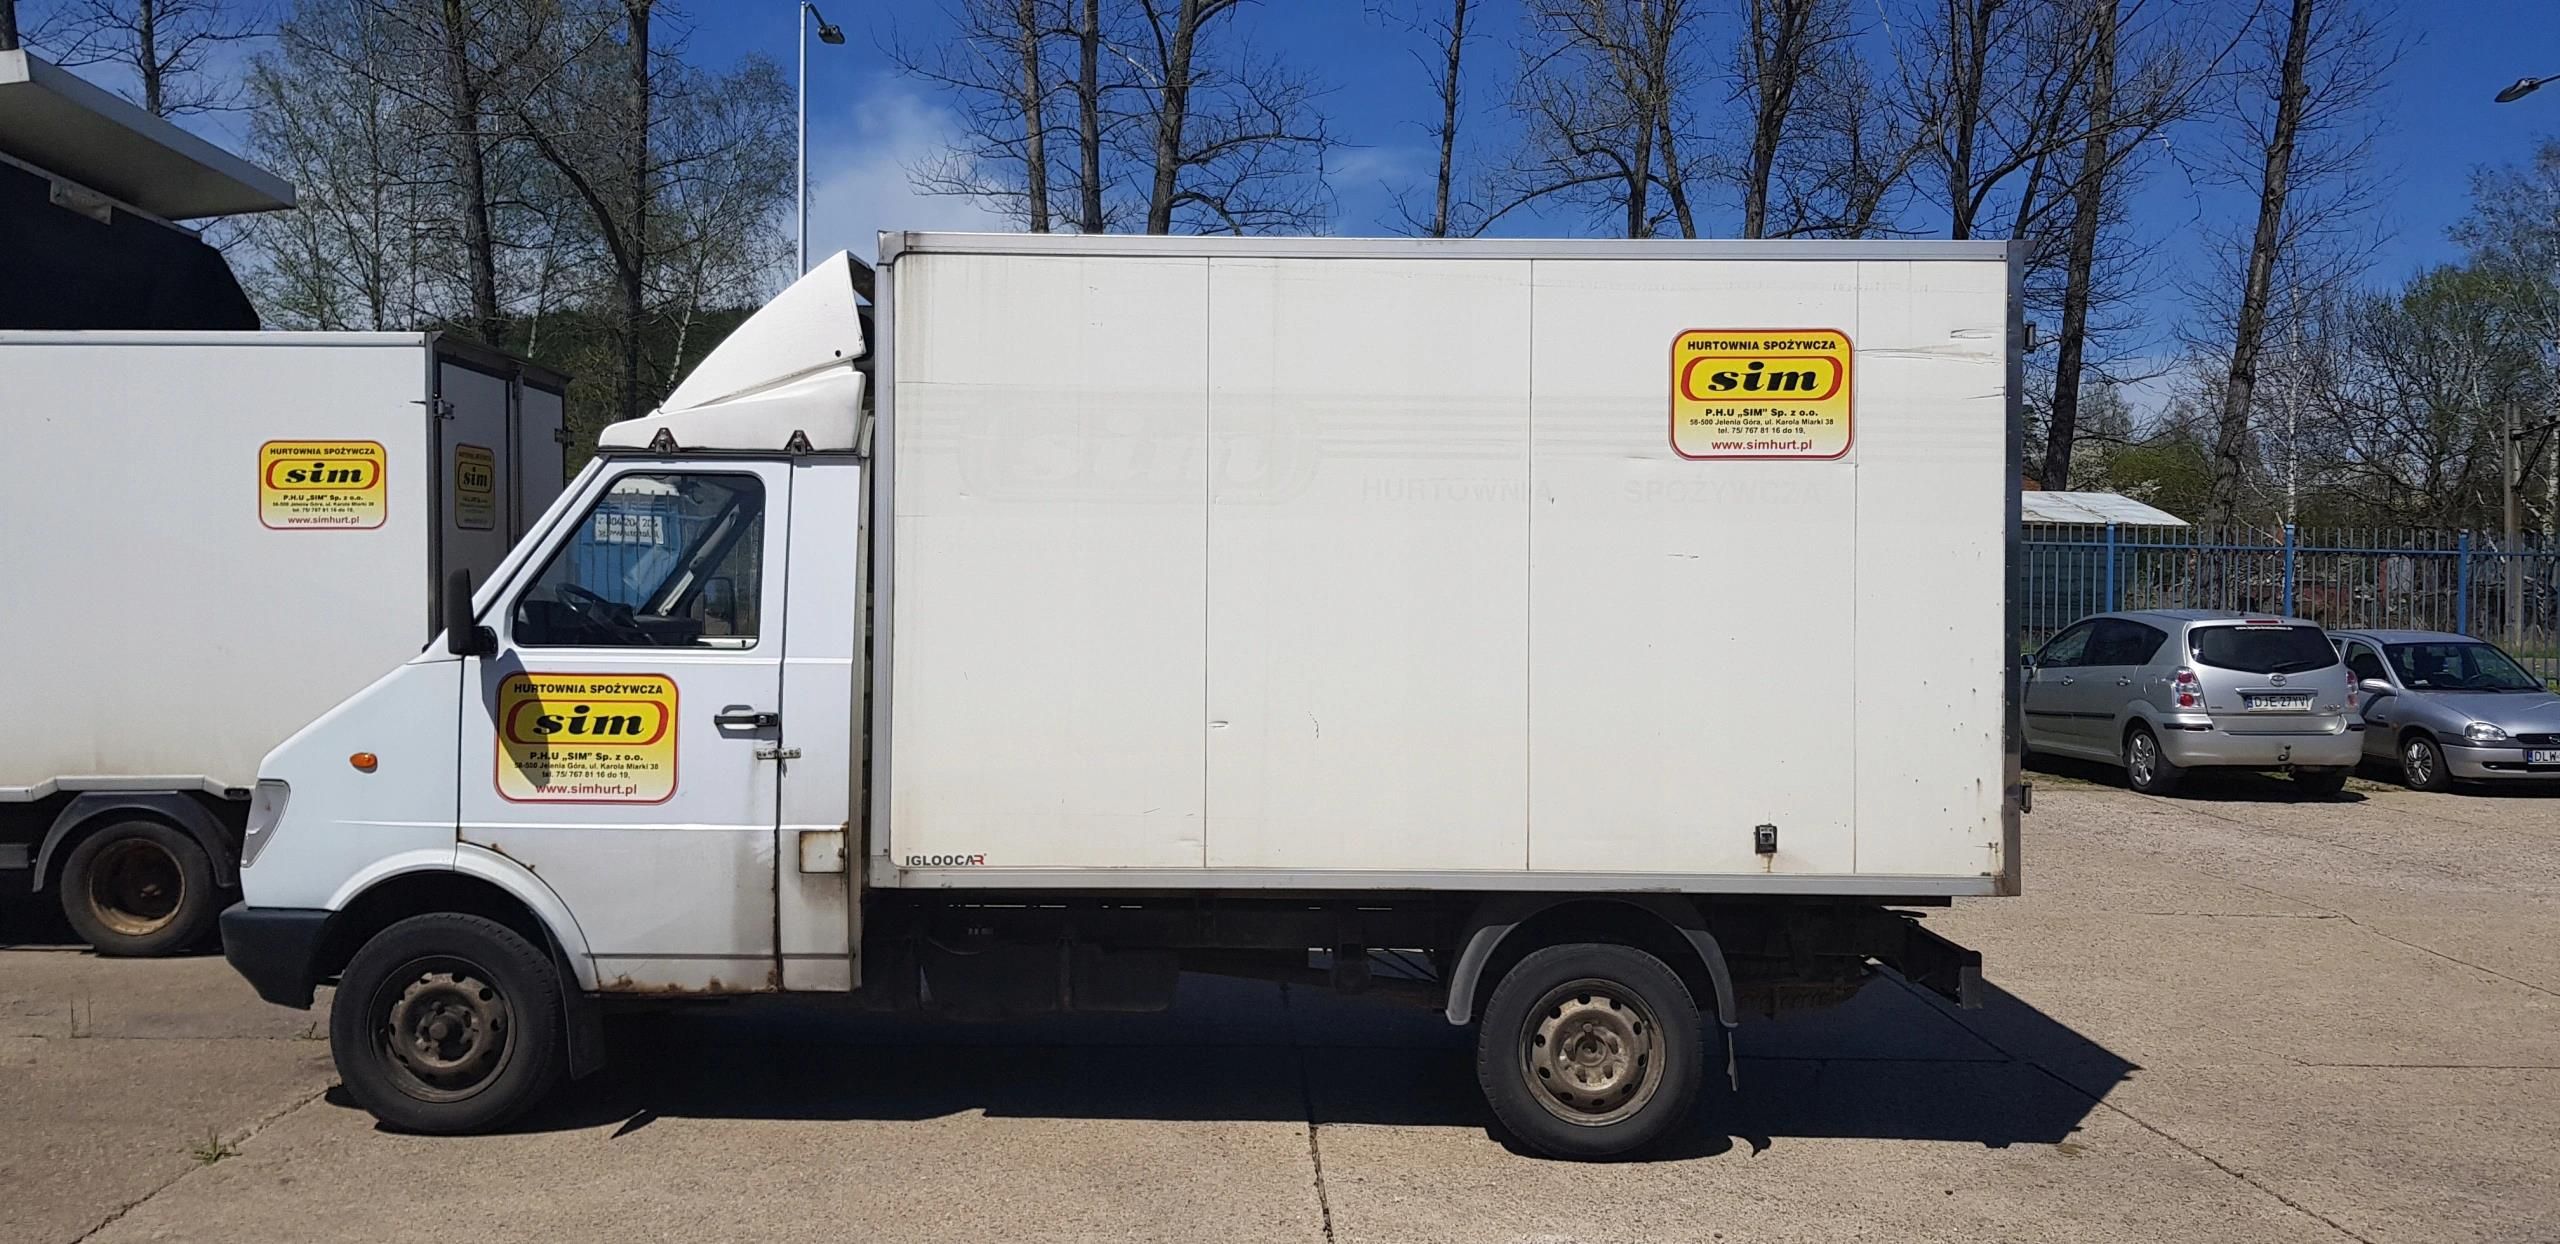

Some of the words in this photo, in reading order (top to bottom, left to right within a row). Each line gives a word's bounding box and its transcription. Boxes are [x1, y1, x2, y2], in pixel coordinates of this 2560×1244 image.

[1688, 340, 1759, 351] HURTOWNIA
[1763, 339, 1836, 350] SPOŻYWCZA
[1708, 361, 1819, 392] sim
[1705, 409, 1735, 417] P.H.U
[1770, 409, 1788, 418] Sp.
[1742, 418, 1762, 426] Góra,
[1795, 427, 1806, 435] 19,
[324, 447, 375, 455] SPOŻYWCZA
[1711, 440, 1812, 452] www.simhurt.pl
[284, 461, 363, 484] sim
[287, 515, 360, 525] www.simhurt.pl
[513, 684, 586, 694] HURTOWNIA
[590, 682, 663, 694] SPOŻYWCZA
[2254, 696, 2278, 707] DJE
[533, 705, 645, 736] sim
[529, 752, 559, 761] P.H.U
[595, 752, 613, 762] Sp.
[2535, 751, 2557, 762] DLW
[567, 762, 587, 770] Góra,
[596, 771, 605, 779] 16
[607, 771, 618, 779] do
[535, 783, 637, 797] www.simhurt.pl
[906, 855, 985, 866] IGLOOCAR
